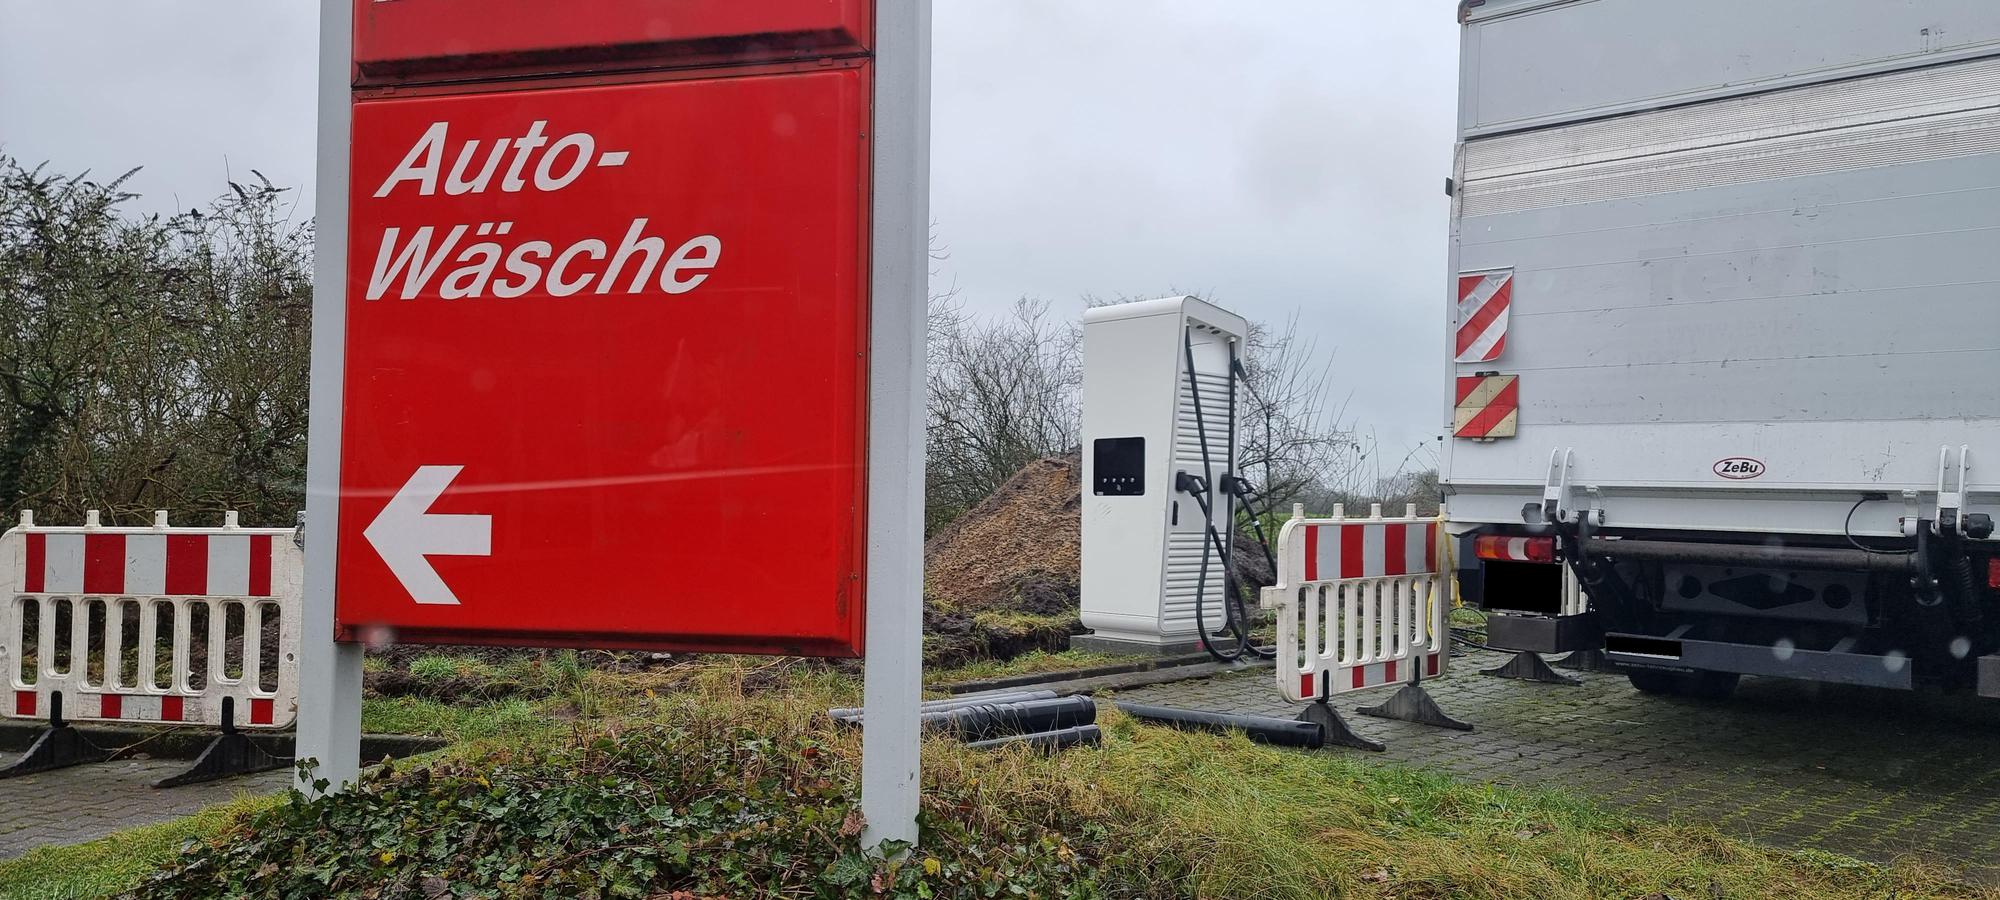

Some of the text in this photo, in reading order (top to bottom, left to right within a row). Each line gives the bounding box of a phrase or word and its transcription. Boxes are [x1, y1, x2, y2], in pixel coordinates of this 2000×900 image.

[373, 120, 630, 198] Auto-
[365, 217, 722, 301] Wäsche
[1722, 461, 1759, 473] ZeBu
